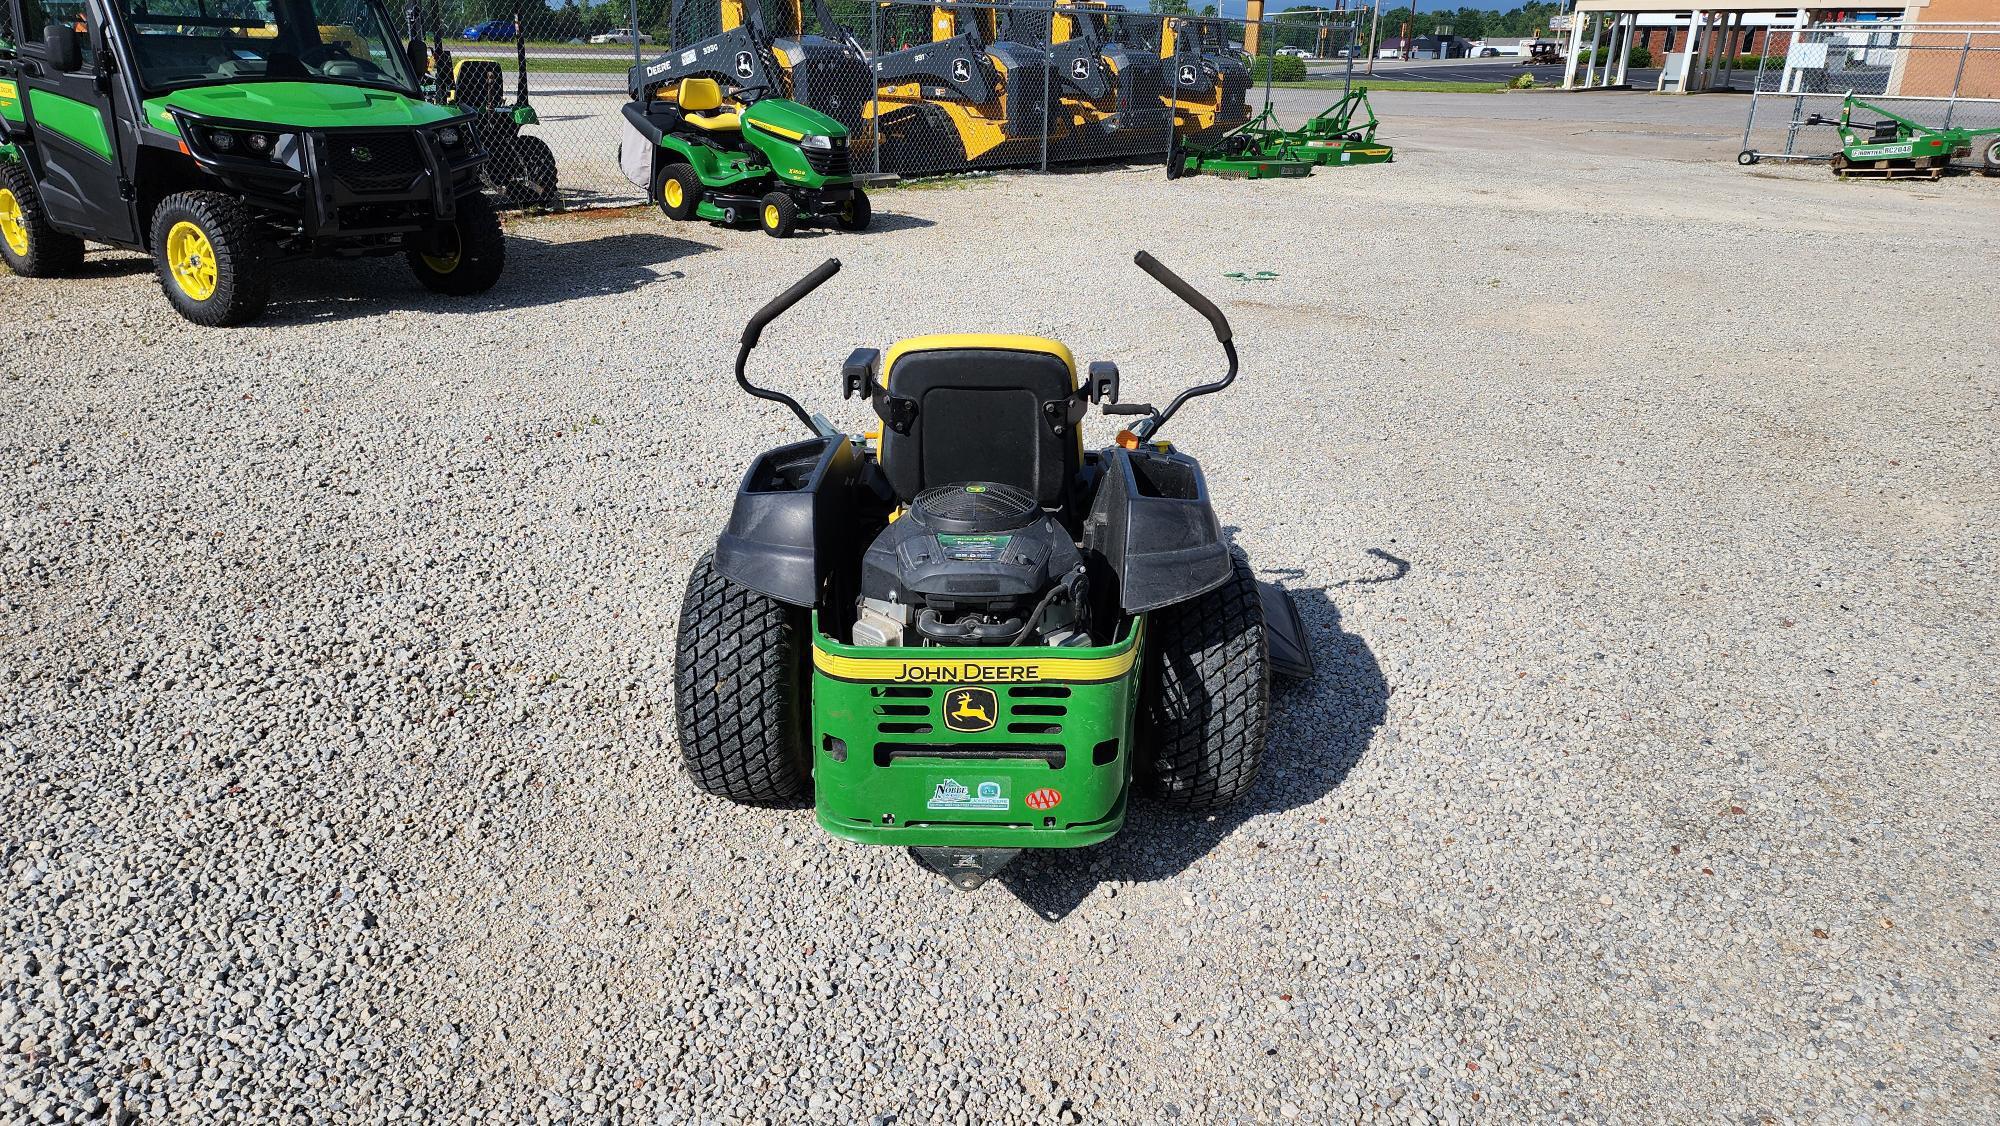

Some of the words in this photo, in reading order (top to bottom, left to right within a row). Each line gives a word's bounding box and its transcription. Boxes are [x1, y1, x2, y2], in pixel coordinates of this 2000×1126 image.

[646, 60, 672, 77] DEERE
[1884, 146, 1912, 154] RC2048
[895, 664, 957, 679] JOHN
[964, 664, 1039, 679] DEERE
[1027, 790, 1059, 808] AAA
